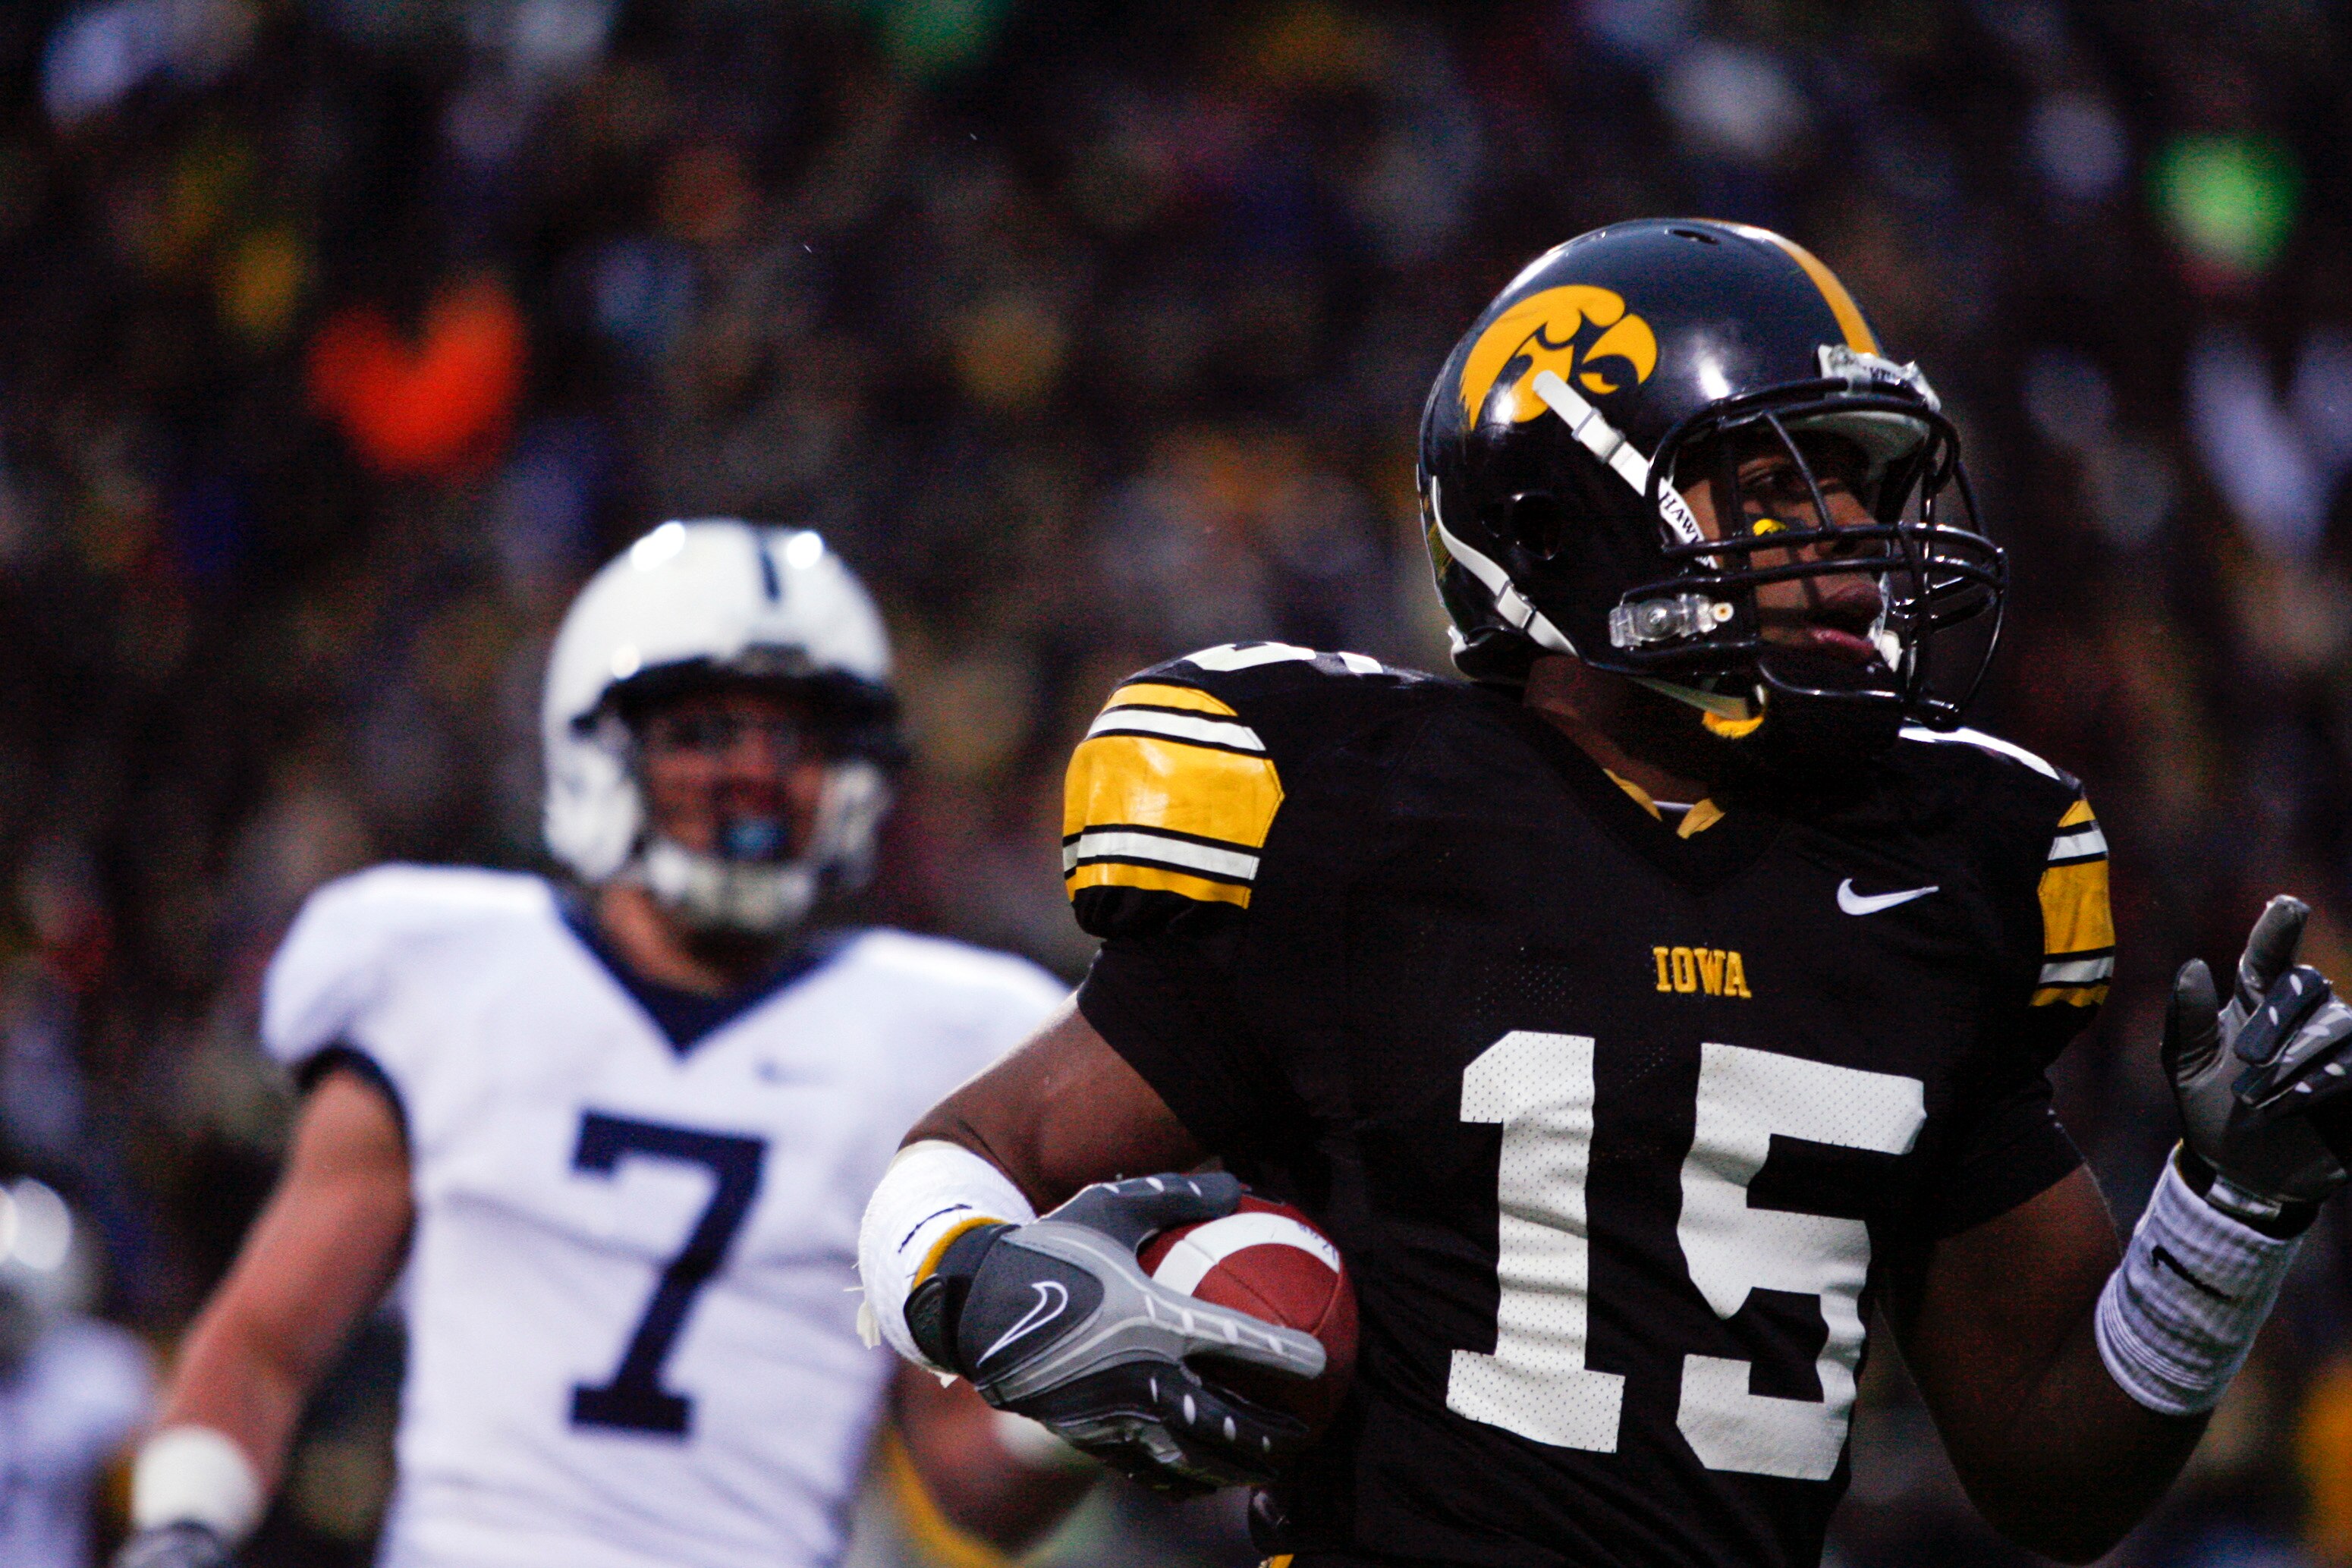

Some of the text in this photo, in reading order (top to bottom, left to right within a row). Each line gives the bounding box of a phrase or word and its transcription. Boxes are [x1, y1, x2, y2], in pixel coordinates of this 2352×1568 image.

[1652, 946, 1752, 998] IOWA
[569, 1111, 769, 1437] 7
[1446, 1030, 1927, 1481] 15
